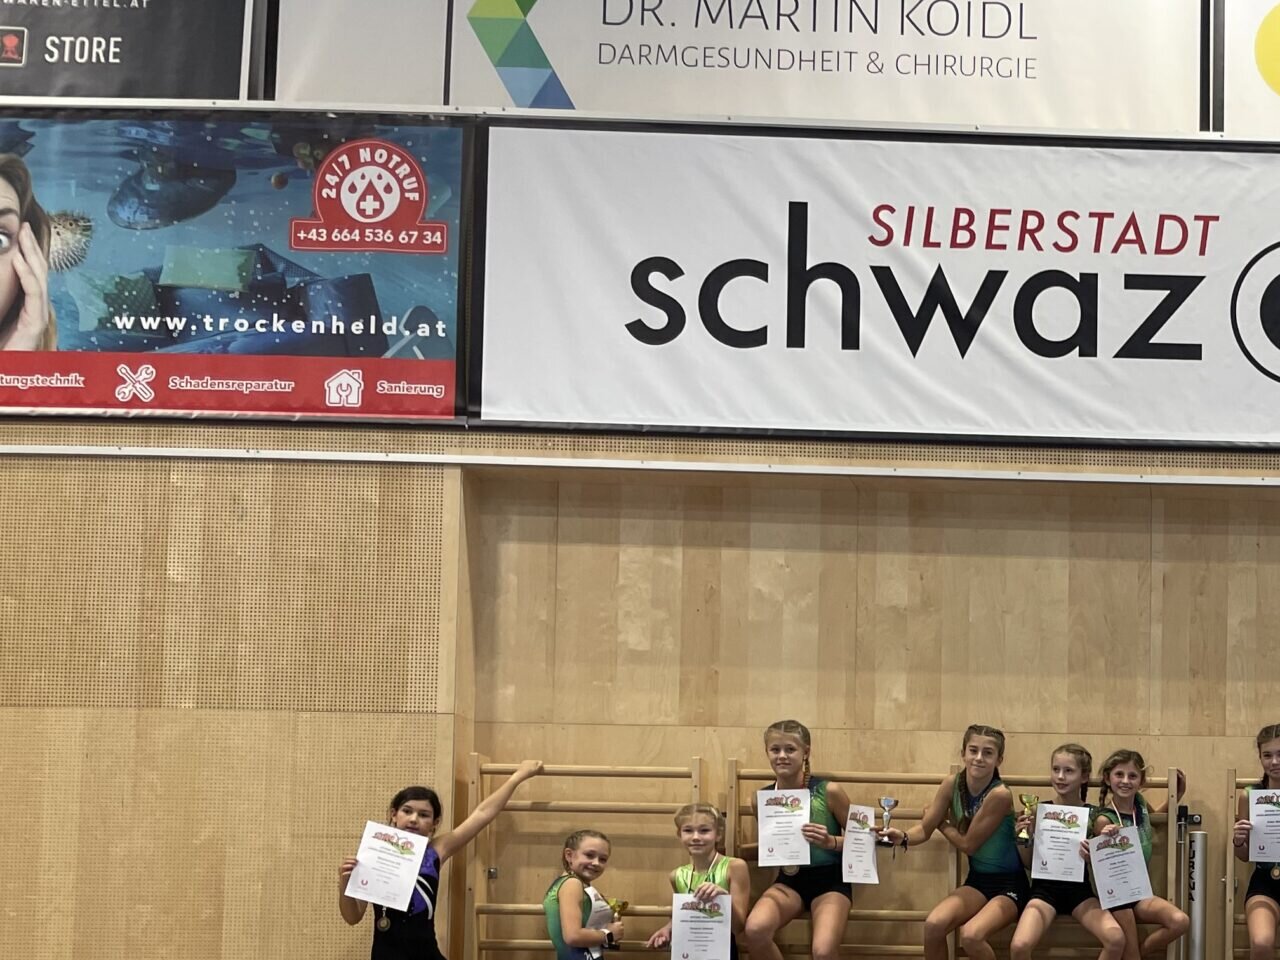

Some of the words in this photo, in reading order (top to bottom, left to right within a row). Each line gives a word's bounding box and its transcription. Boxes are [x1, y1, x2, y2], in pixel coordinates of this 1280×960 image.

[602, 0, 676, 27] DR.
[694, 0, 878, 34] MARTIN
[900, 0, 1038, 40] KOIDL
[44, 35, 122, 64] STORE
[598, 42, 858, 72] DARMGESUNDHEIT
[866, 51, 884, 75] &
[895, 53, 1038, 80] CHIRURGIE
[322, 154, 351, 199] 24/7
[358, 147, 420, 201] NOTRUF
[297, 229, 328, 242] +43
[331, 229, 361, 242] 664
[364, 230, 394, 243] 536
[399, 231, 419, 244] 67
[422, 231, 443, 245] 34
[867, 204, 1221, 258] SILBERSTADT
[625, 201, 1207, 361] schwaz
[114, 313, 447, 338] www.trockenheld.at
[0, 373, 85, 390] tungstechnik
[168, 375, 295, 394] Schadensreparatur
[376, 381, 445, 399] Sanierung
